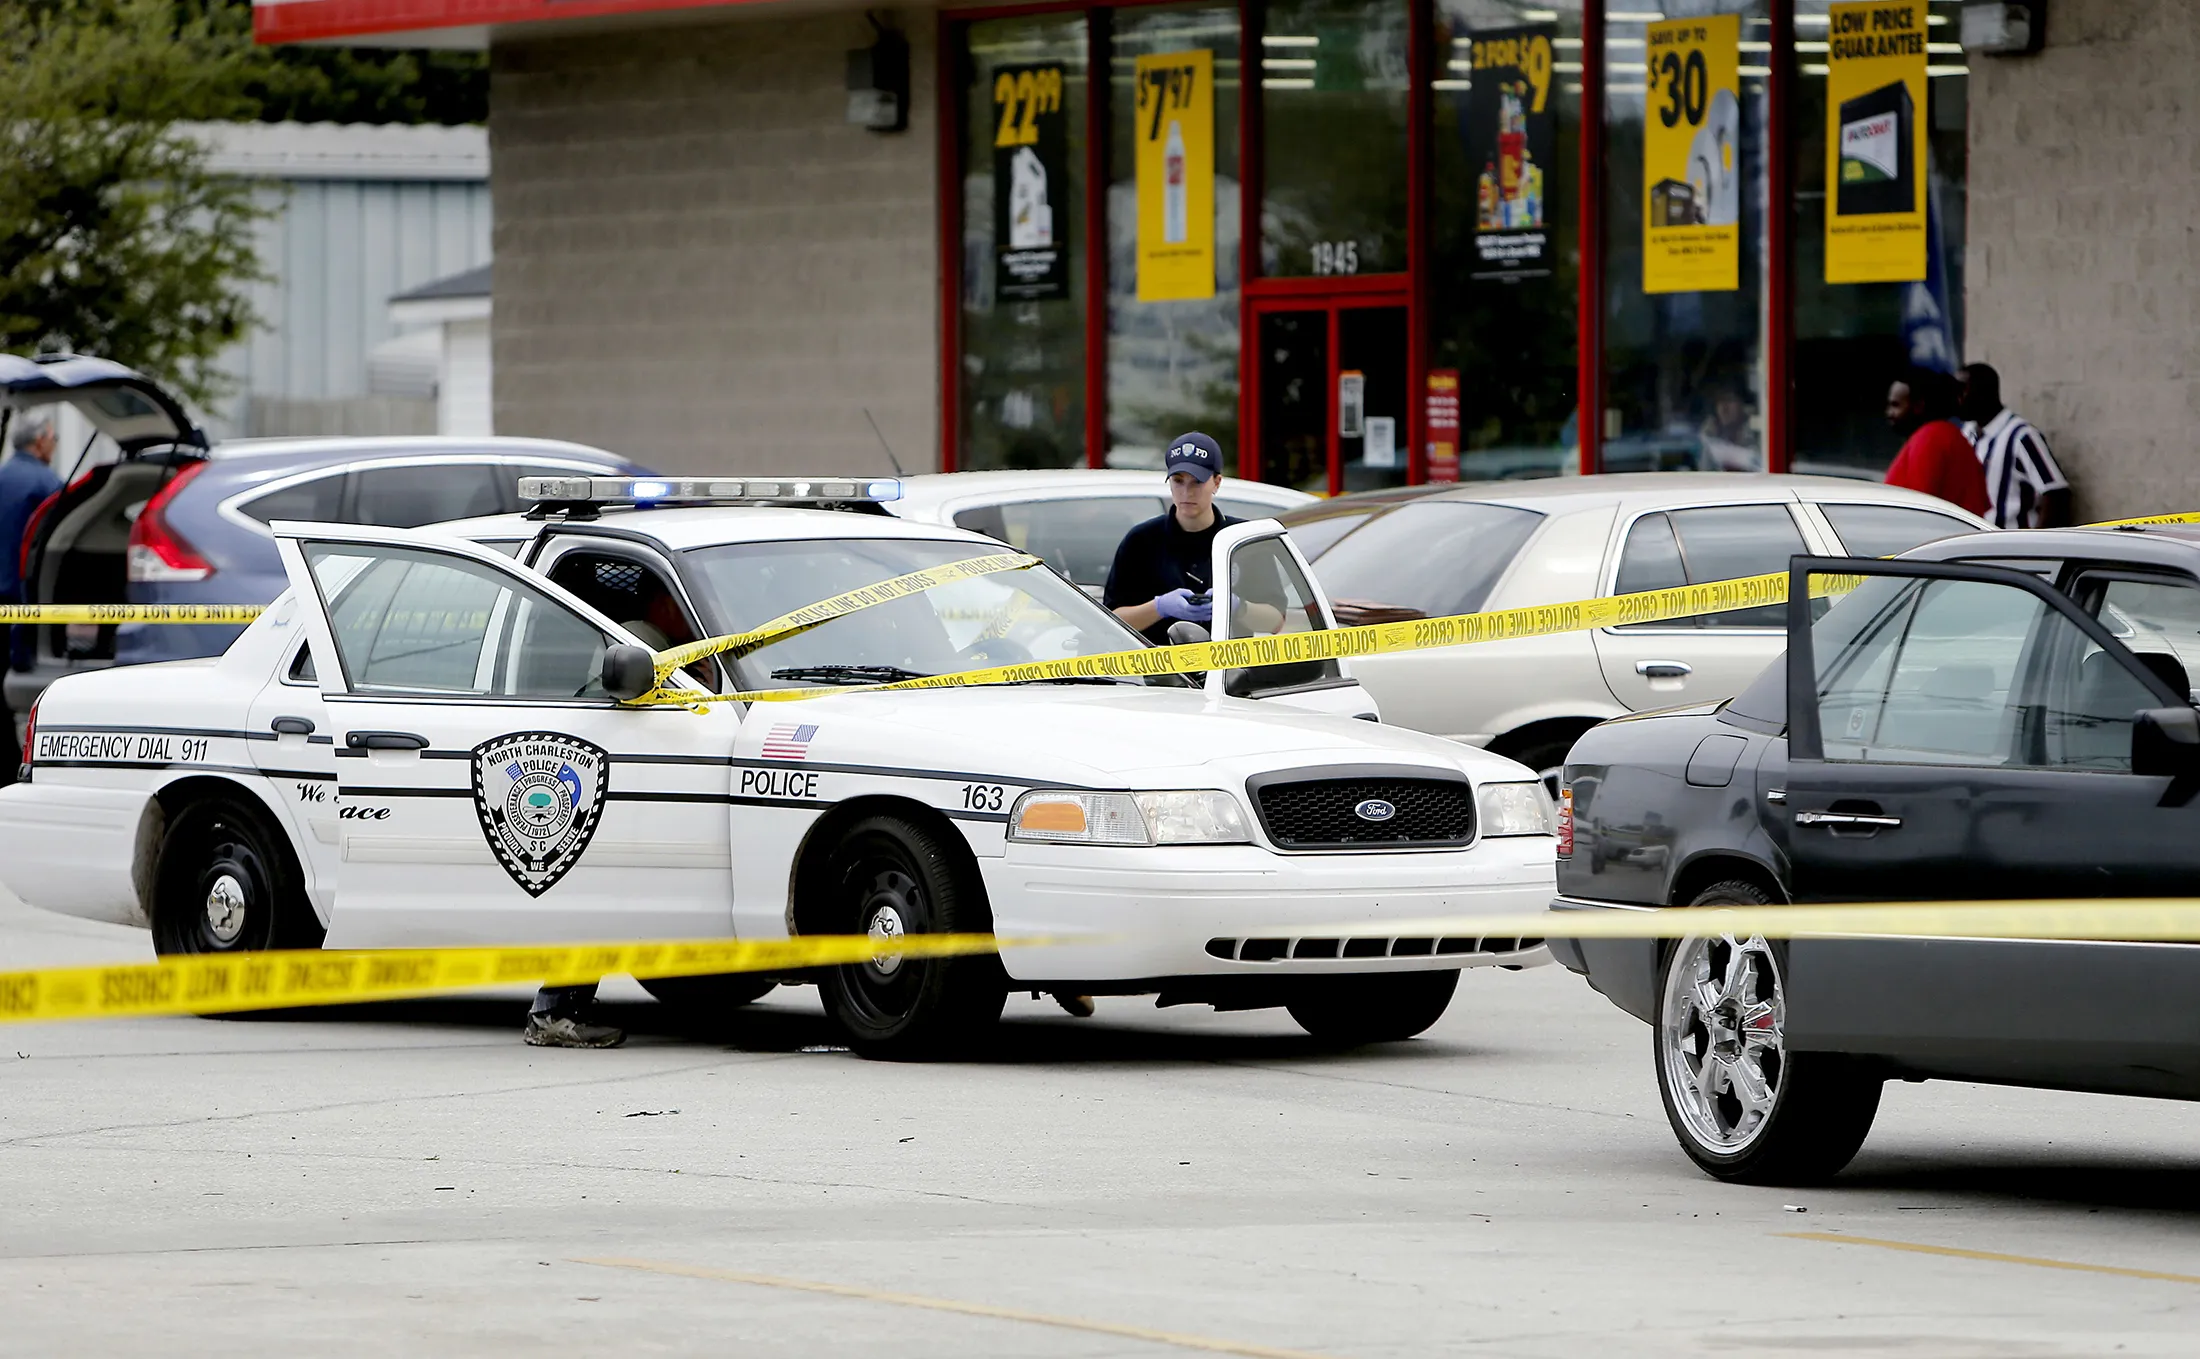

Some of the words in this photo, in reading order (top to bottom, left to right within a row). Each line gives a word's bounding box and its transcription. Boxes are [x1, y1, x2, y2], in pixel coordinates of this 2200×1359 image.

[1834, 10, 1867, 34] LOW
[1873, 6, 1914, 31] PRICE
[1833, 32, 1924, 59] GUARANTEE
[1311, 241, 1358, 276] 1945
[1170, 447, 1182, 458] NC
[1194, 447, 1208, 459] PD
[955, 557, 992, 576] POLICE
[788, 604, 834, 626] POLICE
[830, 597, 858, 616] LINE
[855, 591, 876, 609] DO
[873, 583, 901, 602] NOT
[898, 573, 937, 594] CROSS
[40, 735, 132, 758] EMERGENCY
[137, 737, 173, 759] DIAL
[181, 739, 208, 761] 911
[487, 746, 522, 767] NORTH
[525, 745, 594, 769] CHARLESTON
[523, 760, 558, 773] POLICE
[296, 782, 325, 803] We
[524, 775, 557, 787] PROGRESS
[740, 770, 819, 797] POLICE
[961, 785, 1004, 810] 163
[1366, 803, 1387, 815] Ford
[532, 827, 547, 836] 1972
[498, 822, 525, 858] PROUDLY
[530, 862, 545, 871] WE
[556, 827, 579, 854] SERVE
